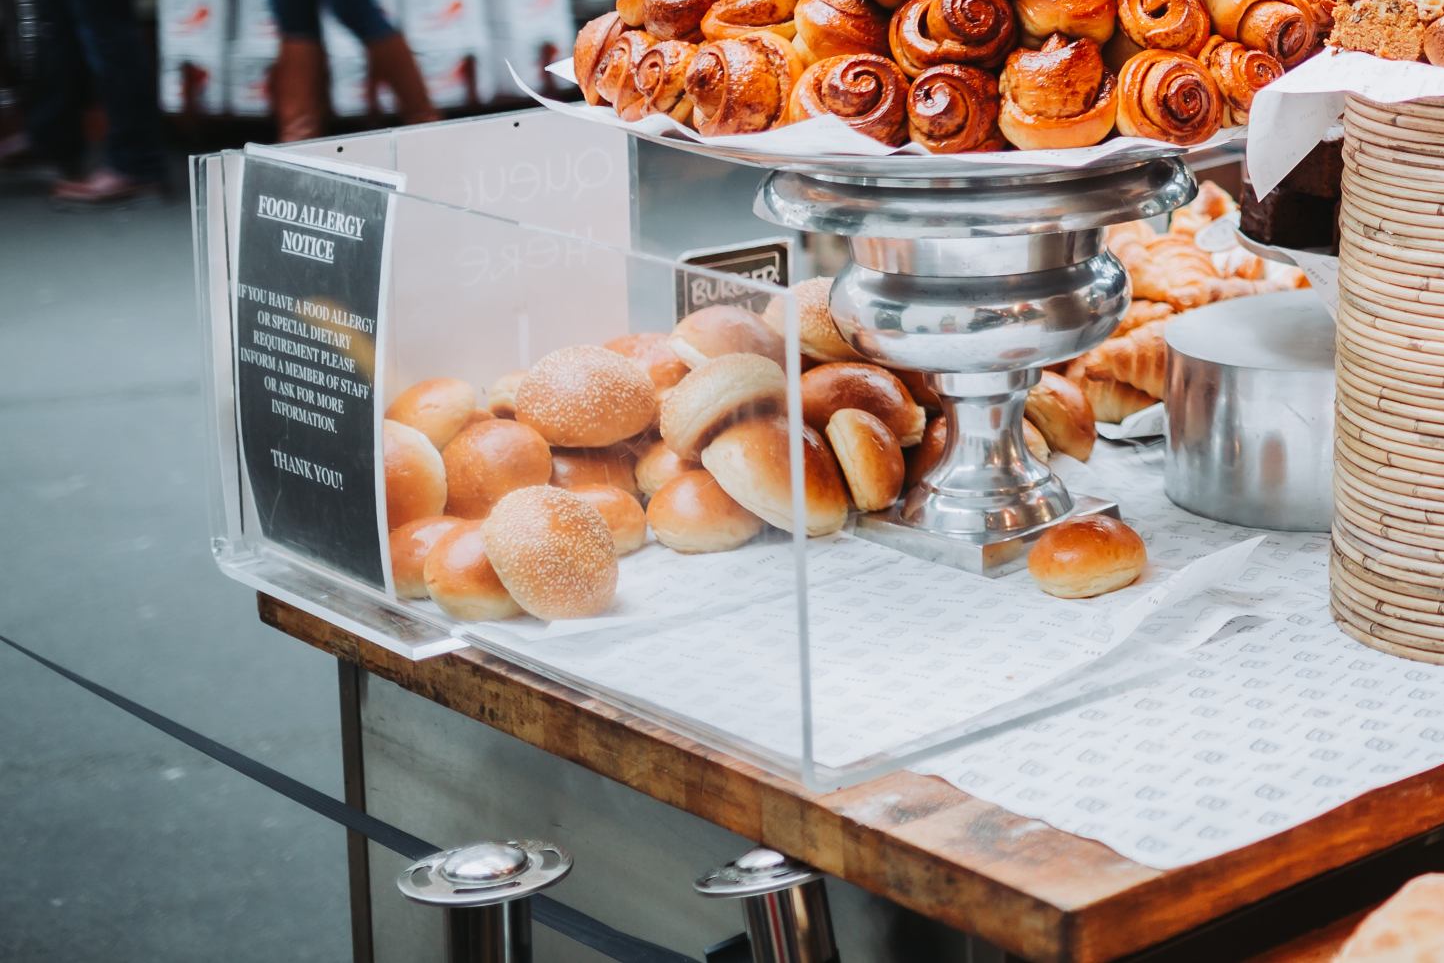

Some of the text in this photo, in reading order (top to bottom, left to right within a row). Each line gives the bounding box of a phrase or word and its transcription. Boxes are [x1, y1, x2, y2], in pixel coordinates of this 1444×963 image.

[257, 195, 366, 238] FOOD ALLERGY
[281, 229, 335, 261] NOTICE
[238, 283, 375, 334] IF YOU HAVE A FOOD ALLERGY
[257, 310, 352, 349] OR SPECIAL DIETARY
[253, 330, 356, 373] REQUIREMENT PLEASE
[240, 347, 370, 400] INFORM A MEMBER OF STAFF
[264, 375, 344, 414] OR ASK FOR MORE
[271, 398, 338, 434] INFORMATION.
[270, 448, 344, 491] THANK YOU!
